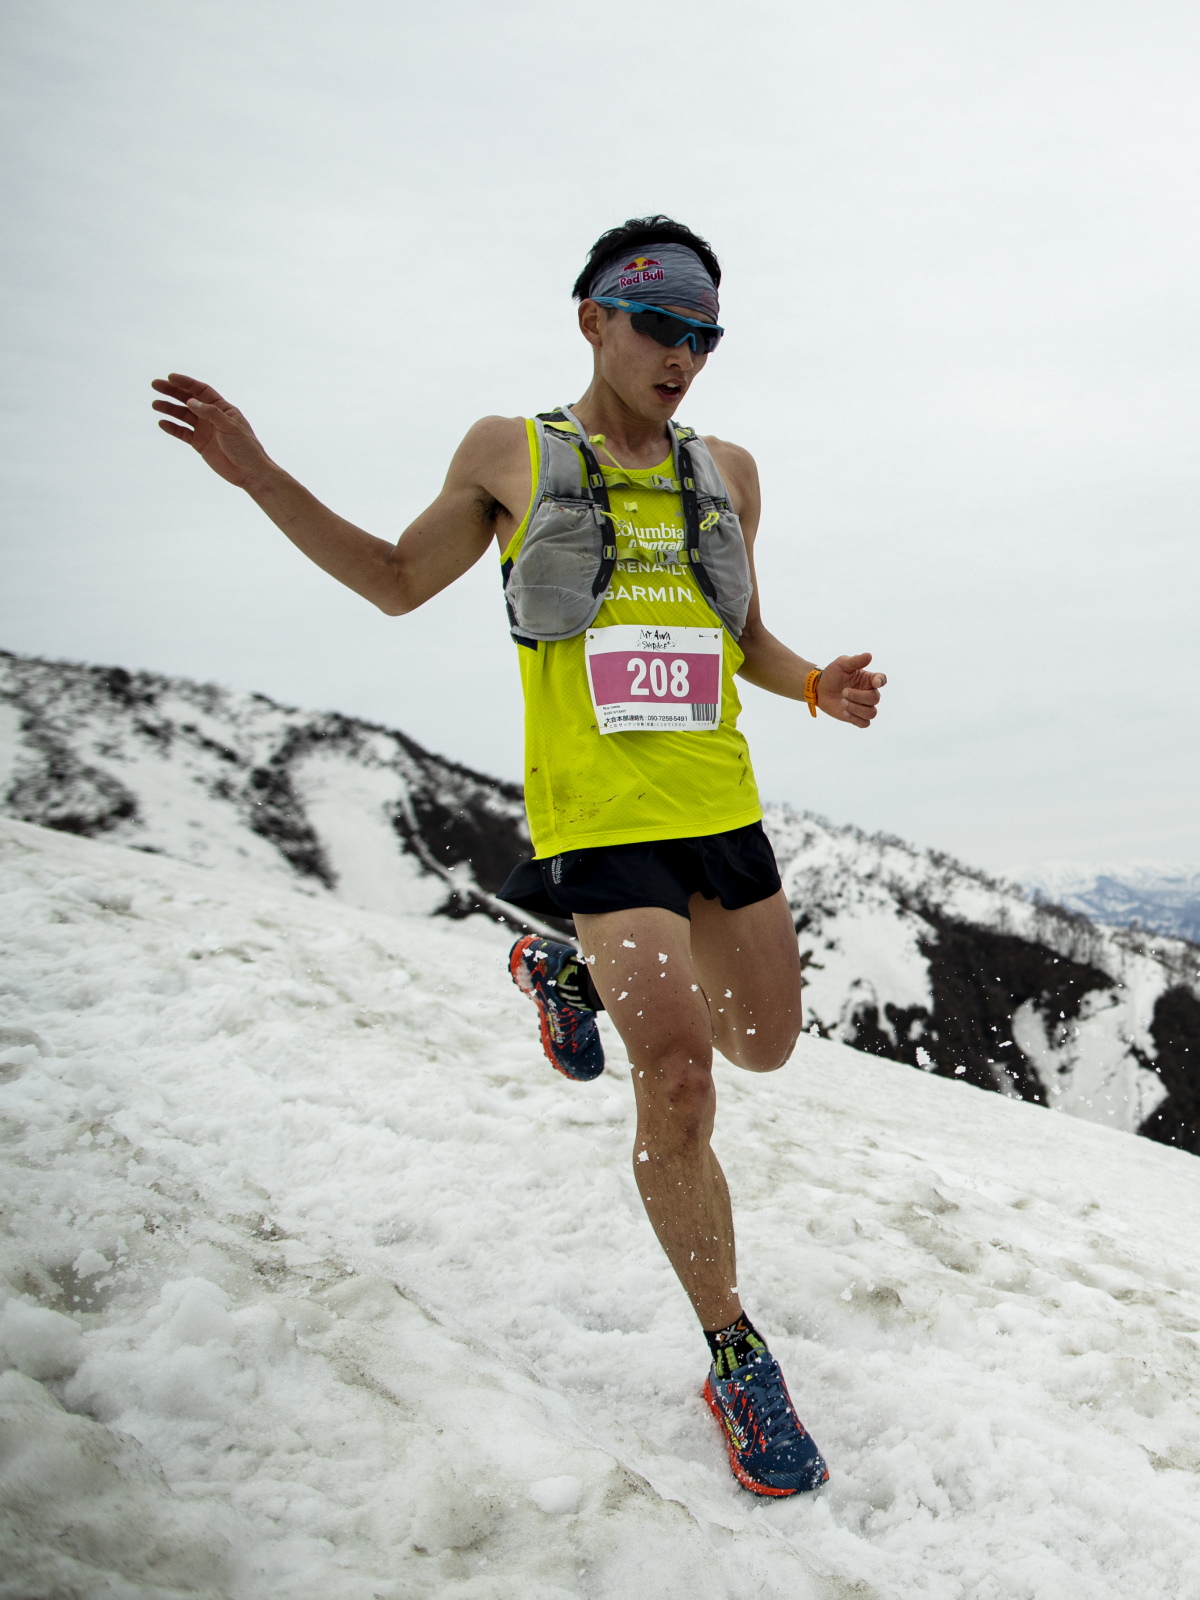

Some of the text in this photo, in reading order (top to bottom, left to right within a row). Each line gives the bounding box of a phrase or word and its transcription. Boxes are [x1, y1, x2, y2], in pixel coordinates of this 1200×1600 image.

[619, 269, 664, 288] Red Bull
[627, 657, 690, 698] 208
